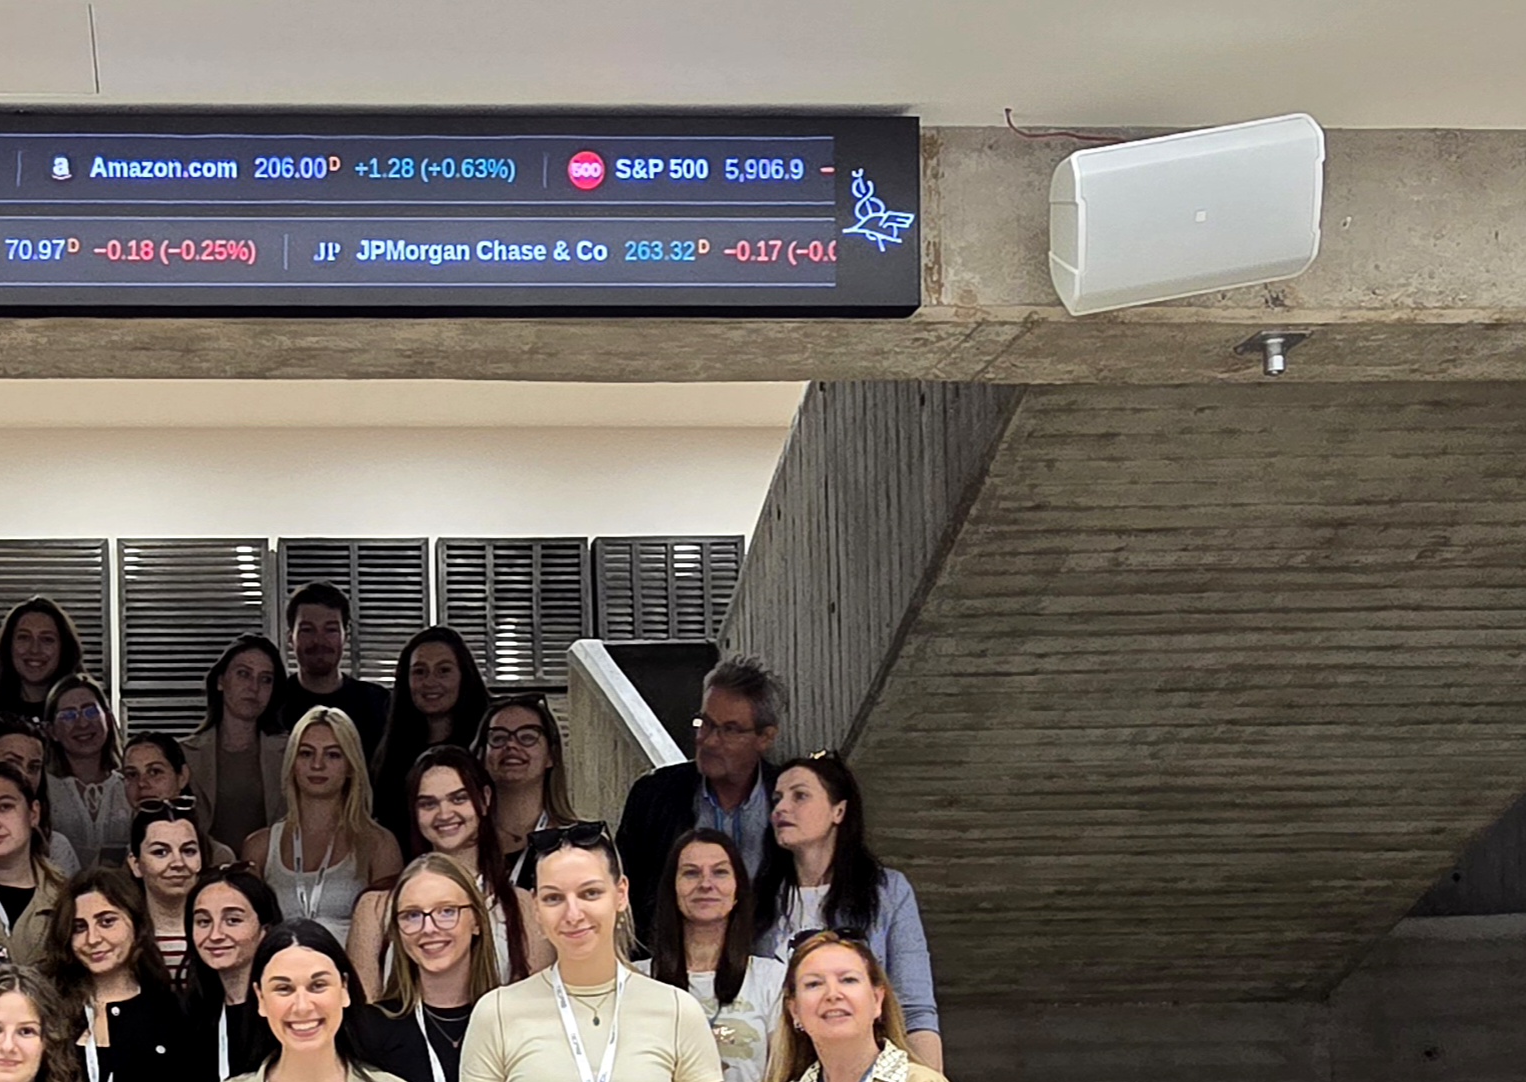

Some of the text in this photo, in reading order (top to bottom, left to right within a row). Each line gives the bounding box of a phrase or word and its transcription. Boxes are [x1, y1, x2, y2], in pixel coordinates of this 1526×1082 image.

[89, 156, 238, 180] Amazon.com
[354, 158, 416, 179] +1.28
[421, 158, 516, 184] (+0.63%)
[571, 162, 602, 178] 500
[615, 158, 804, 183] S&P 500 5,906.9
[93, 239, 155, 261] -0.18
[160, 240, 257, 265] (-0.25%)
[356, 239, 471, 266] JPMorgan
[475, 239, 548, 262] Chase
[552, 240, 572, 262] &
[576, 240, 608, 262] Co
[724, 240, 783, 262] -0.17
